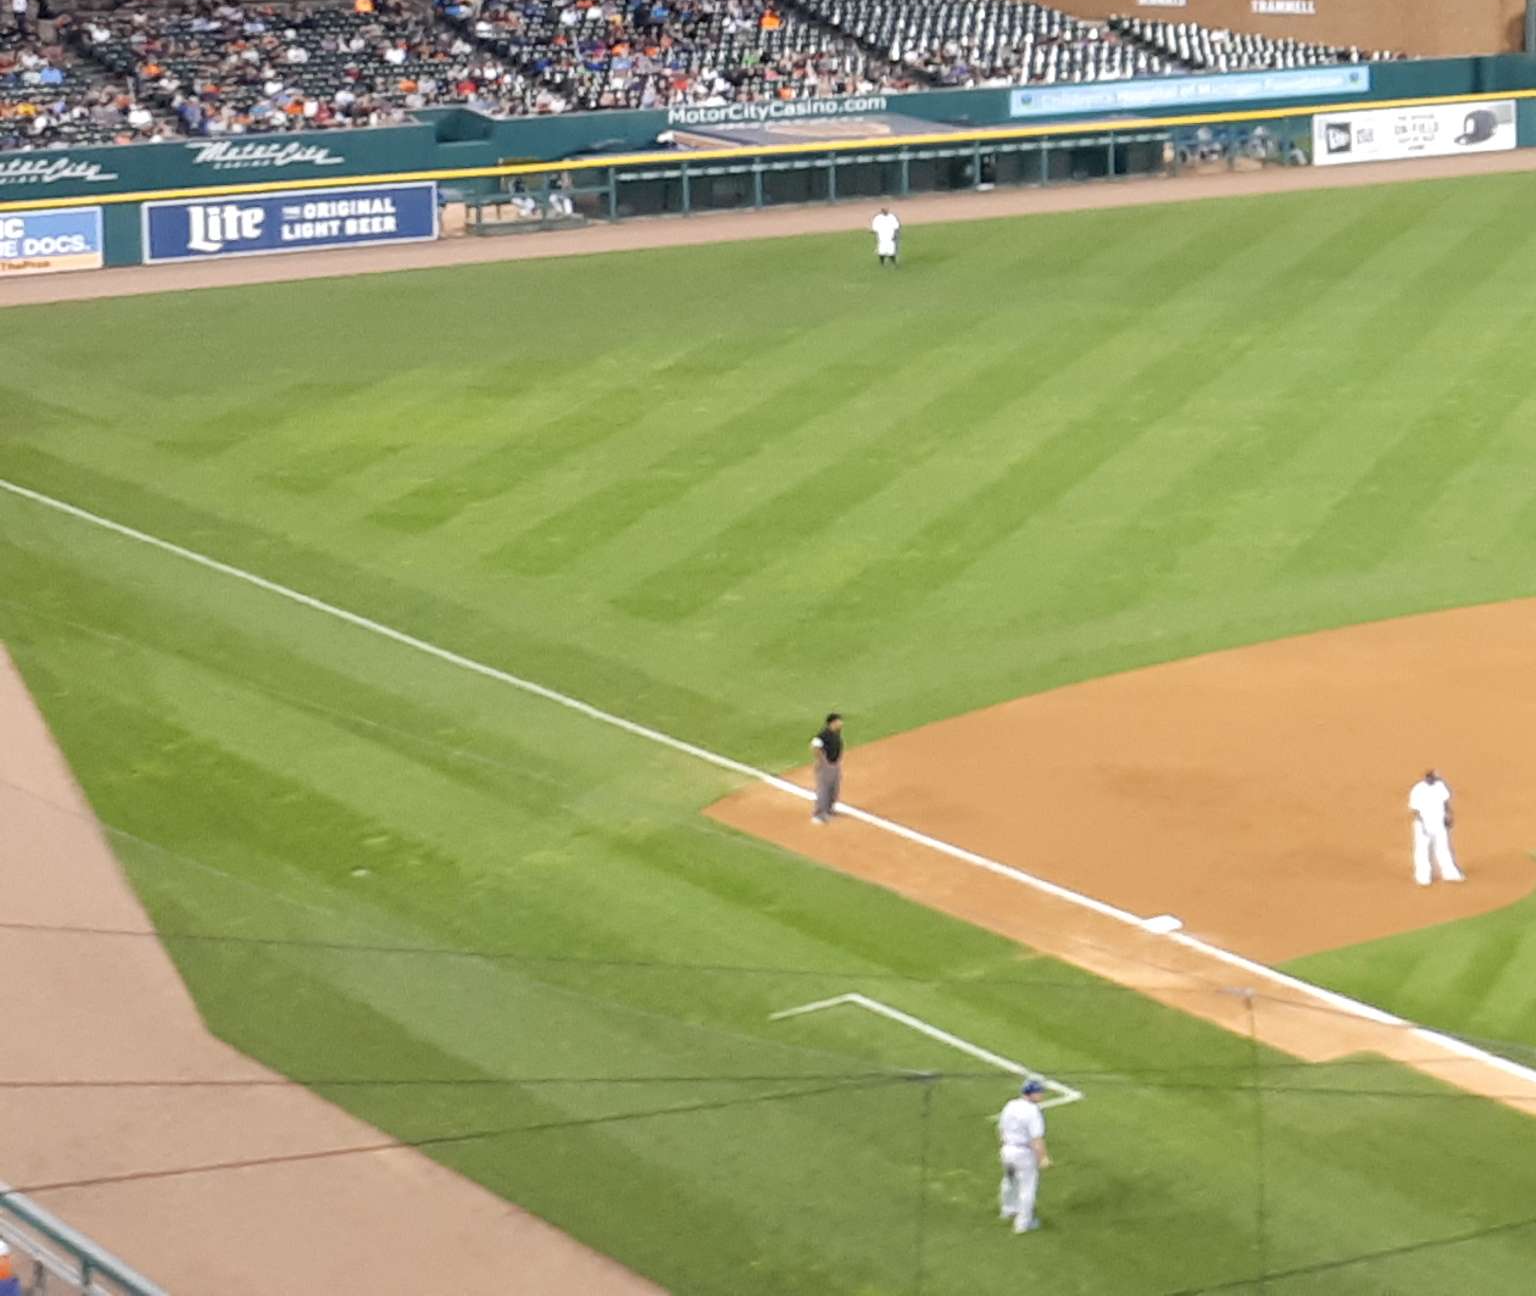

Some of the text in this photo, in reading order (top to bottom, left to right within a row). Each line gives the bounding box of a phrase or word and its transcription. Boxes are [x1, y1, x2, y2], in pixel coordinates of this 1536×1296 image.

[667, 95, 888, 125] MotorCityCasino.com
[303, 197, 397, 220] ORIGINAL
[187, 204, 265, 252] Lite
[281, 215, 397, 241] LIGHT BEER
[22, 234, 91, 256] DOCS.
